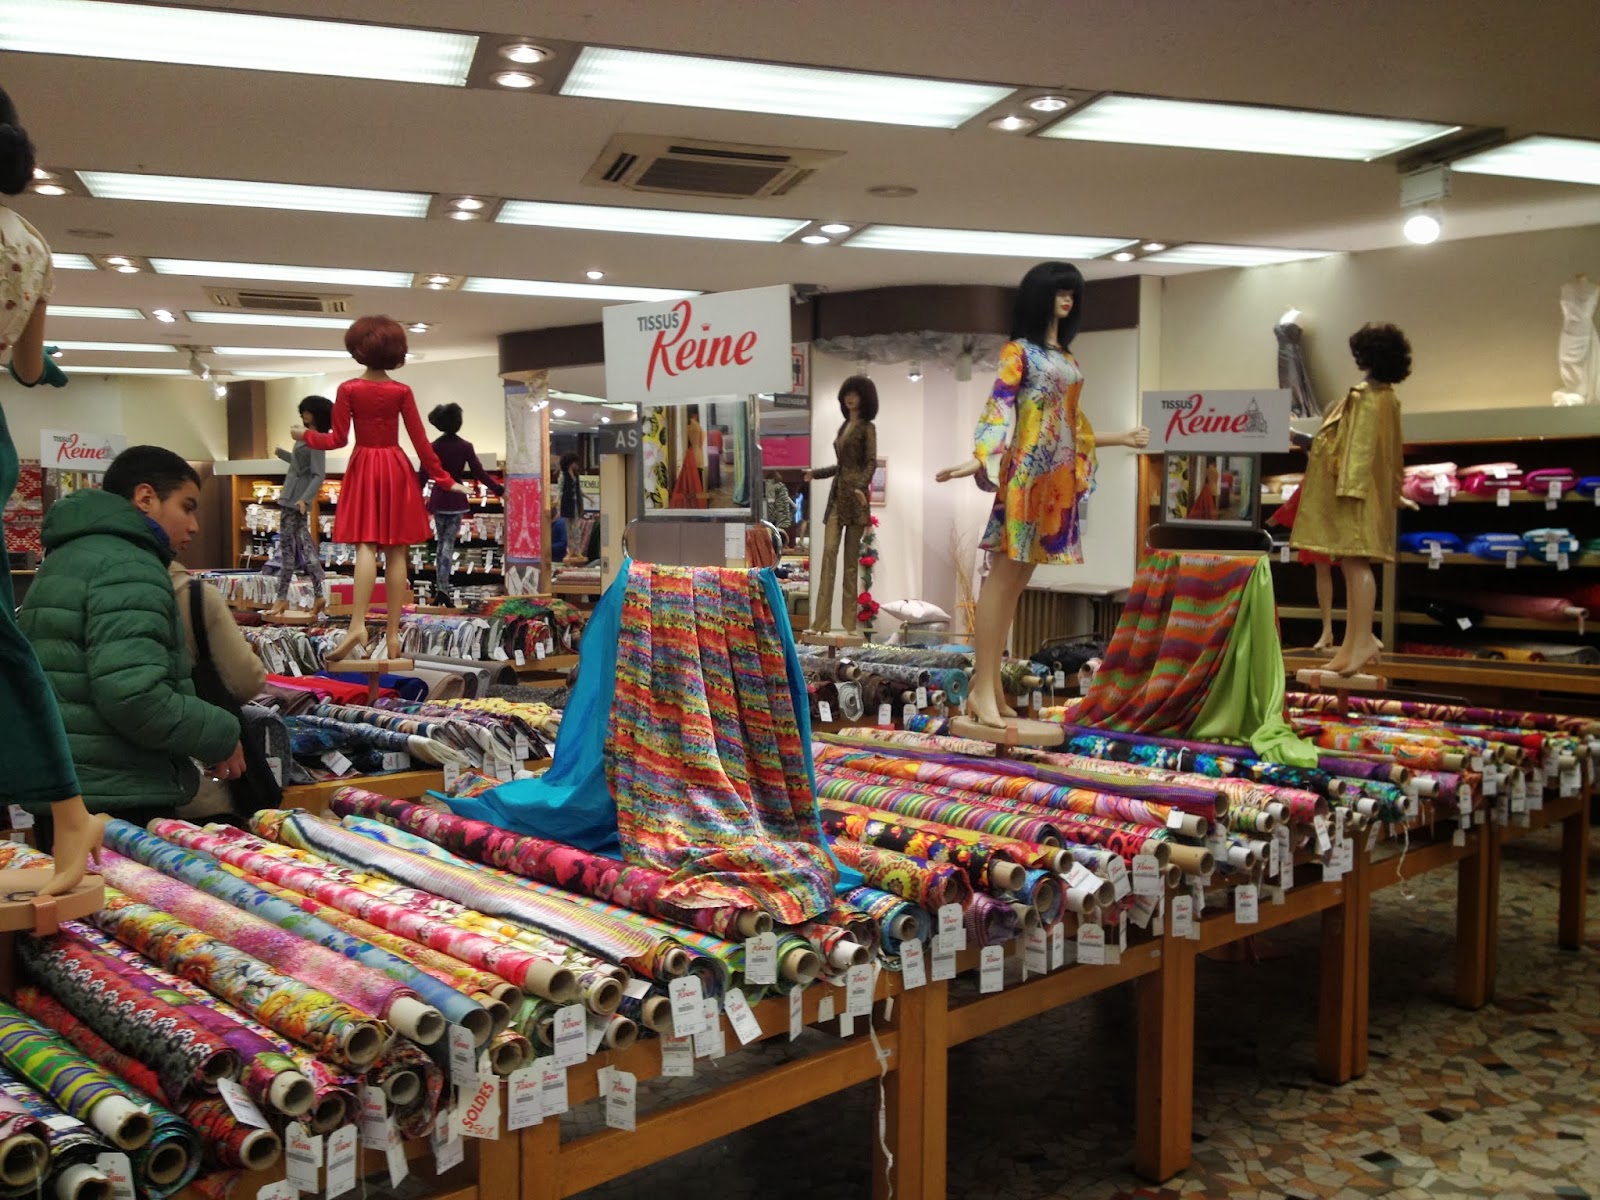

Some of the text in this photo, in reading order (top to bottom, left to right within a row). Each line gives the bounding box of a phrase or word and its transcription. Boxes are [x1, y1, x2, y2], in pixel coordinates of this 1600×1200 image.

[637, 312, 680, 332] TISSUS
[646, 300, 758, 392] Reine
[1161, 399, 1193, 410] TISSUS
[1165, 394, 1249, 444] Reine
[57, 433, 107, 463] Reine
[462, 1081, 495, 1129] SOLDES
